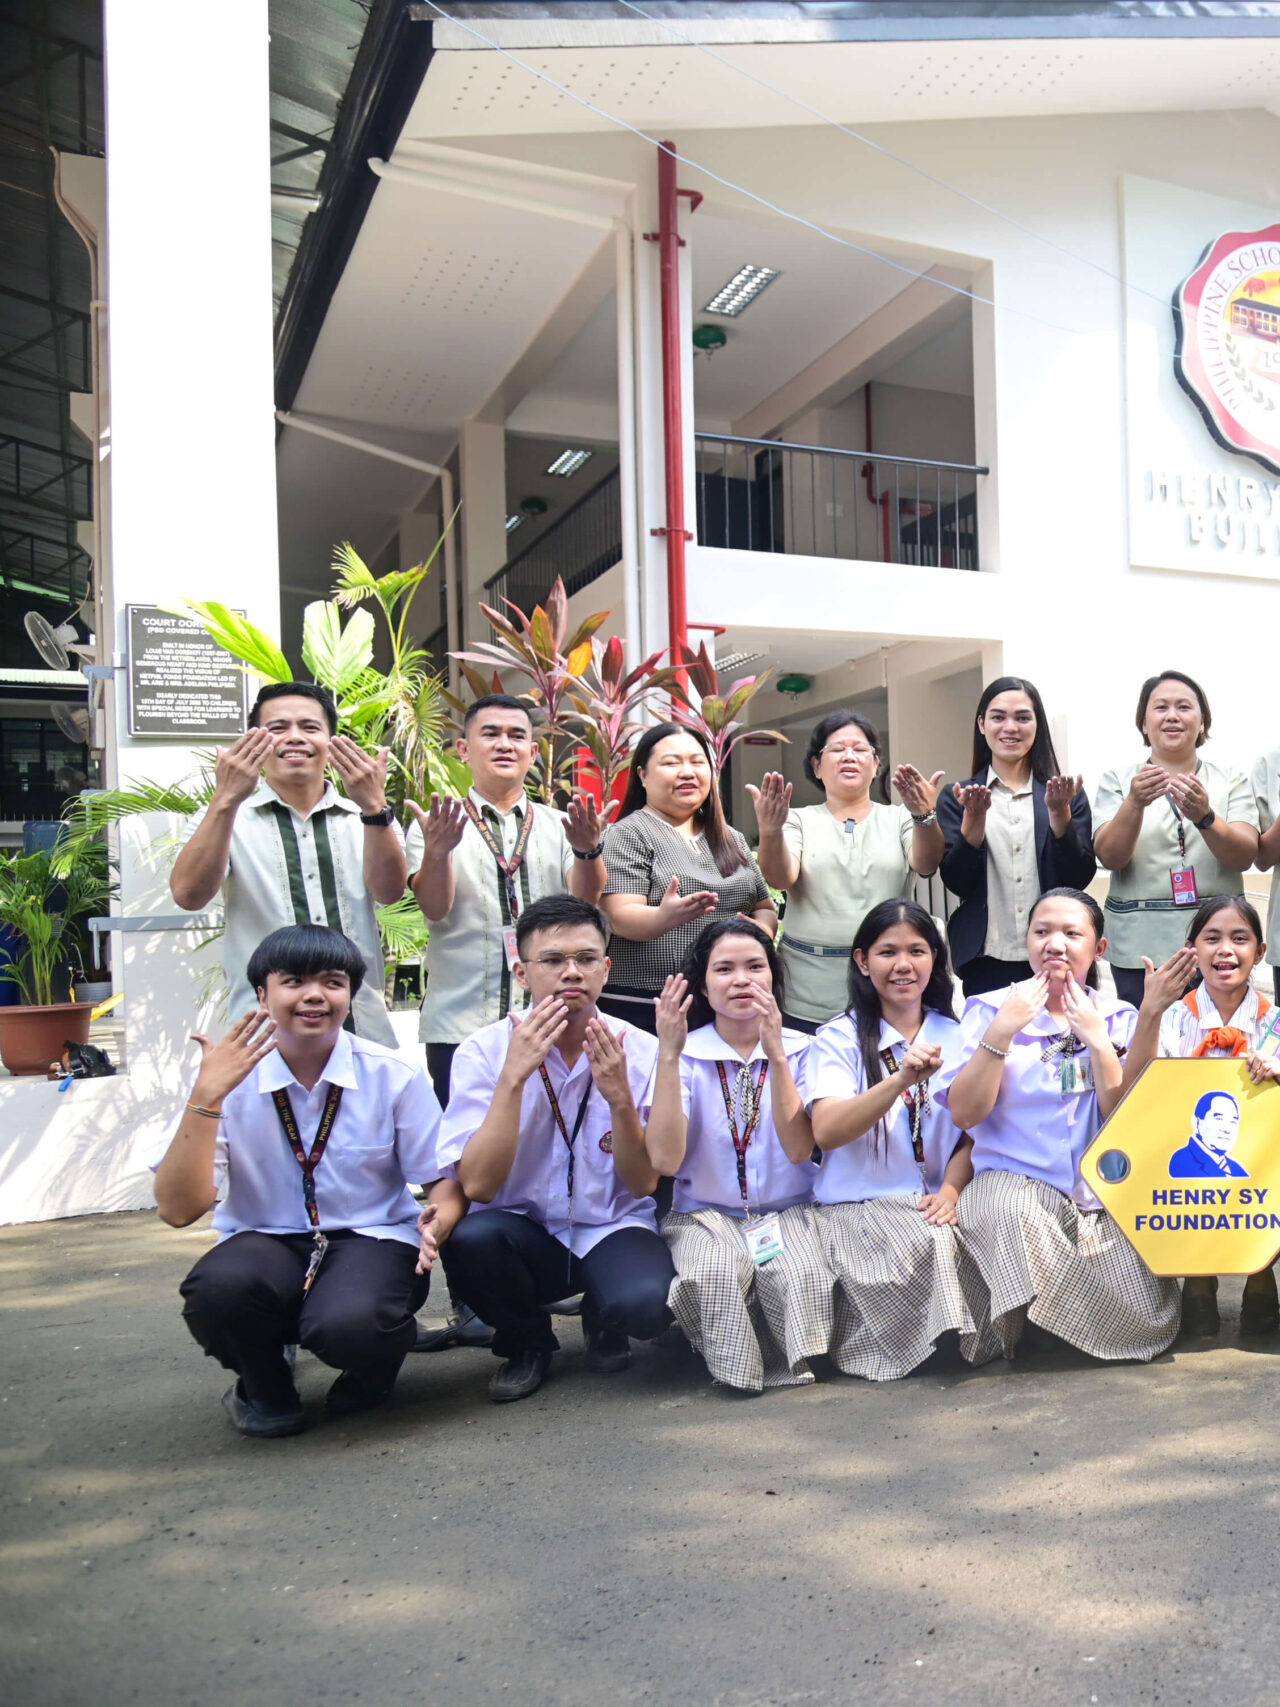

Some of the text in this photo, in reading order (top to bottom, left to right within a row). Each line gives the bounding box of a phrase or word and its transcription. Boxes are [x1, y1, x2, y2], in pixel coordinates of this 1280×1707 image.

[142, 618, 176, 627] COURT
[282, 1107, 291, 1122] THE
[318, 1103, 336, 1142] PHILIPPINE
[286, 1123, 298, 1141] DEAF
[1152, 1188, 1268, 1206] HENRY SY
